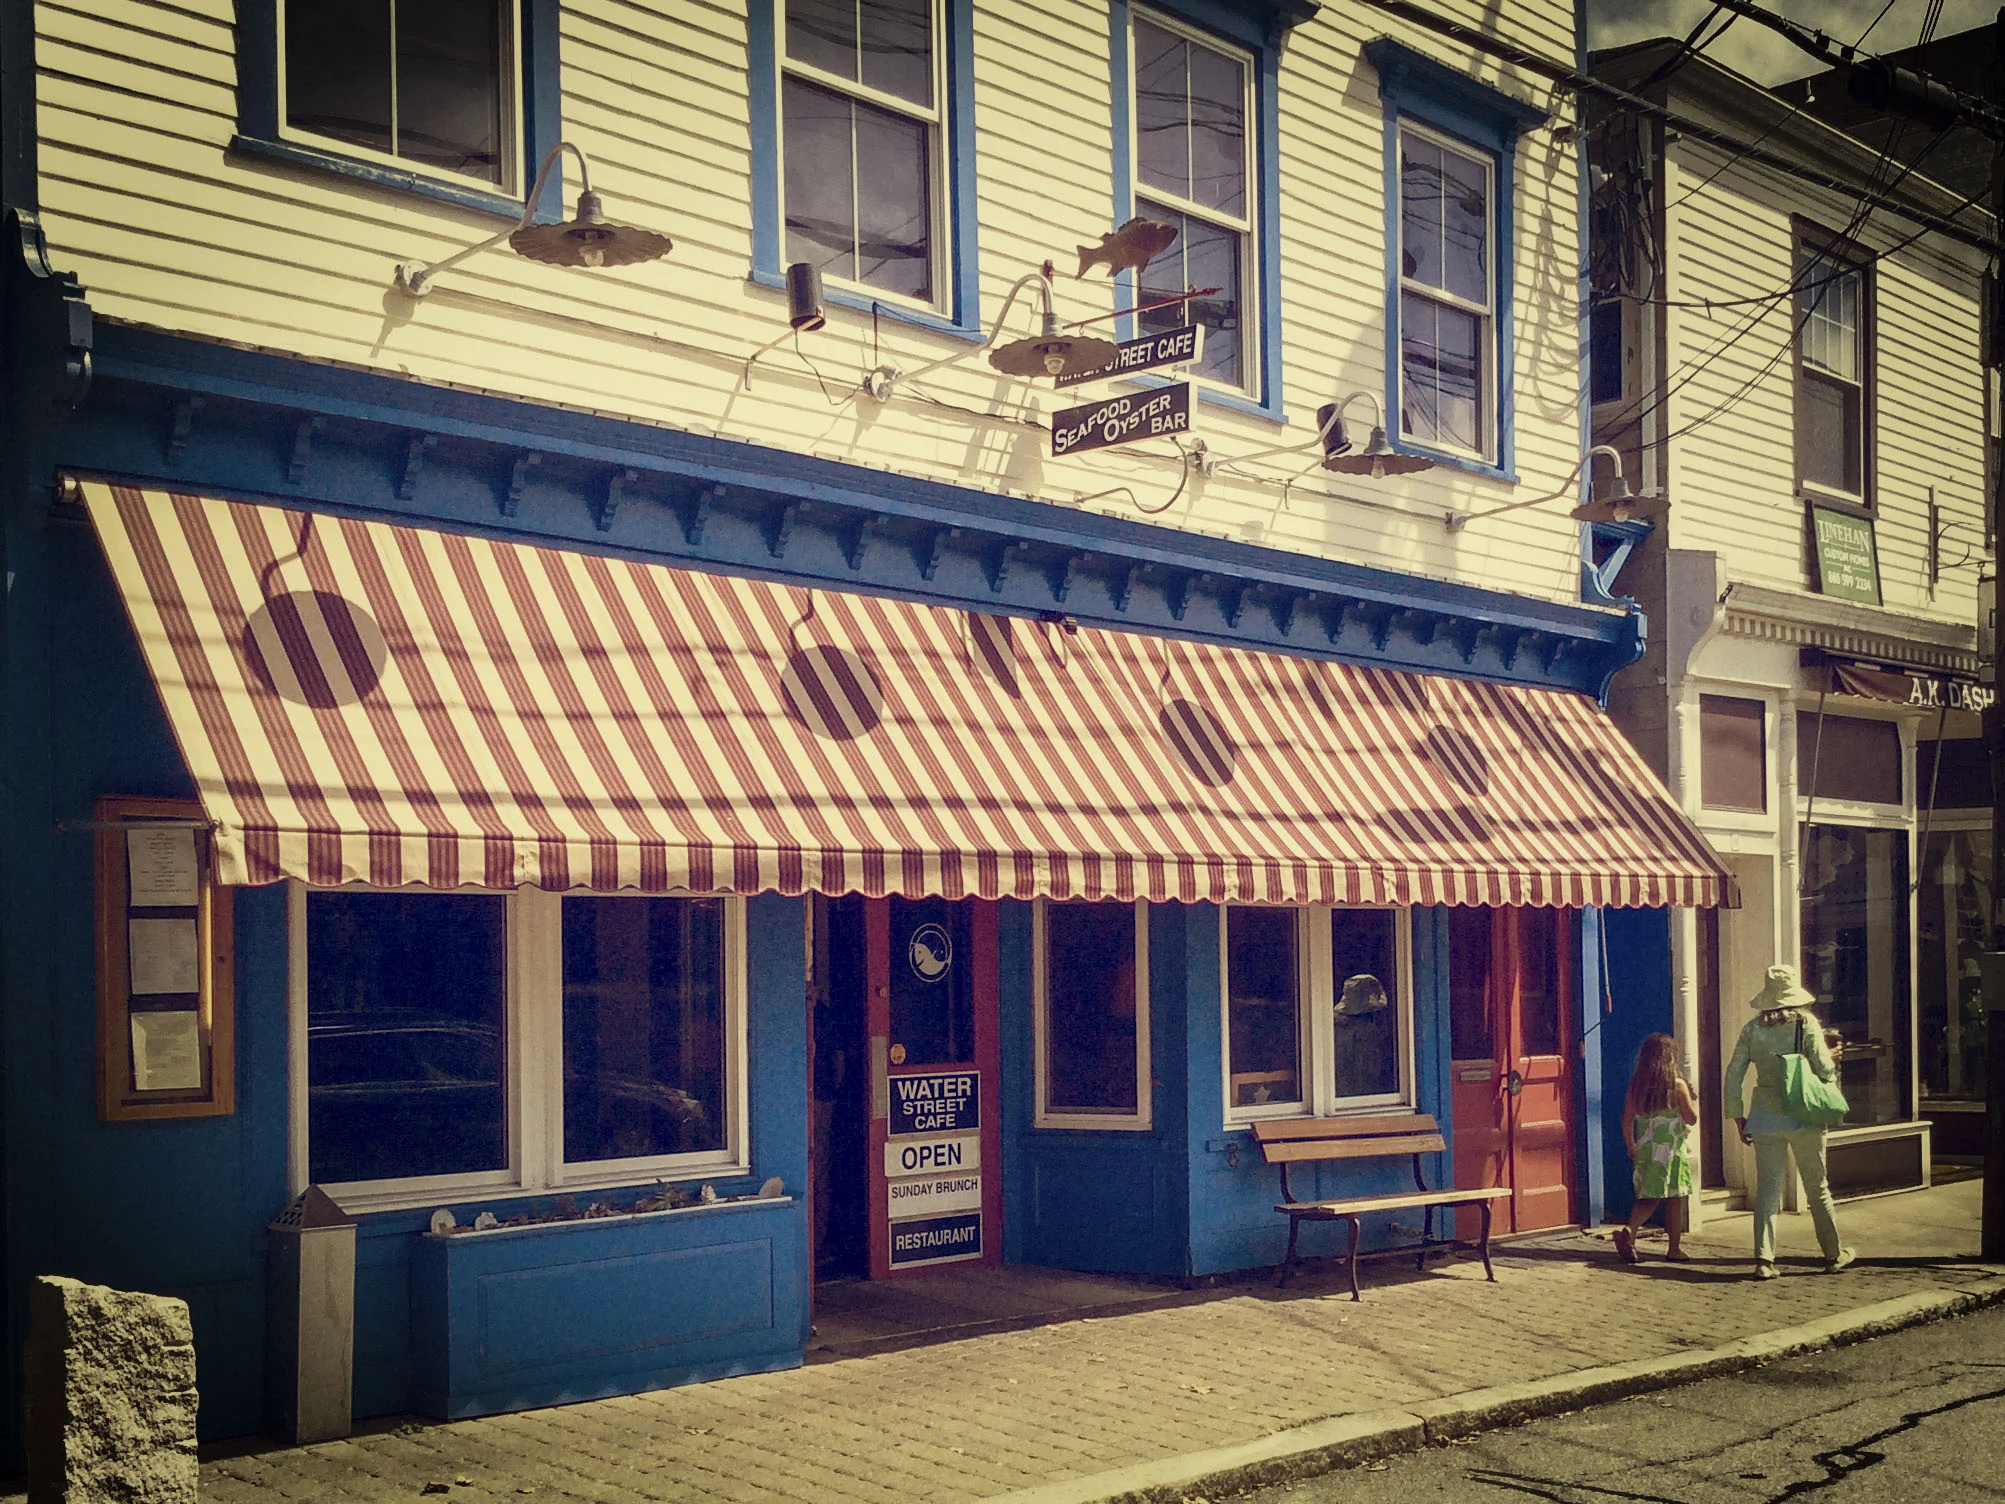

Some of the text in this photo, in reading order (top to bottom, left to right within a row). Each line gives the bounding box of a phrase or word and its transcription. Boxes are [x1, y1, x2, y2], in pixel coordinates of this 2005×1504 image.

[1157, 333, 1193, 359] CAFE
[1054, 399, 1131, 453] SEAFOOD
[1103, 394, 1171, 442] OYSTER
[1151, 412, 1186, 434] BAR
[1817, 519, 1870, 553] LINEHAN
[897, 1077, 972, 1100] WATER
[902, 1098, 967, 1115] STREET
[914, 1114, 956, 1130] CAFE
[901, 1142, 962, 1170] OPEN
[891, 1178, 978, 1199] SUNDAY BRUNCH
[895, 1225, 976, 1251] RESTAURANT
